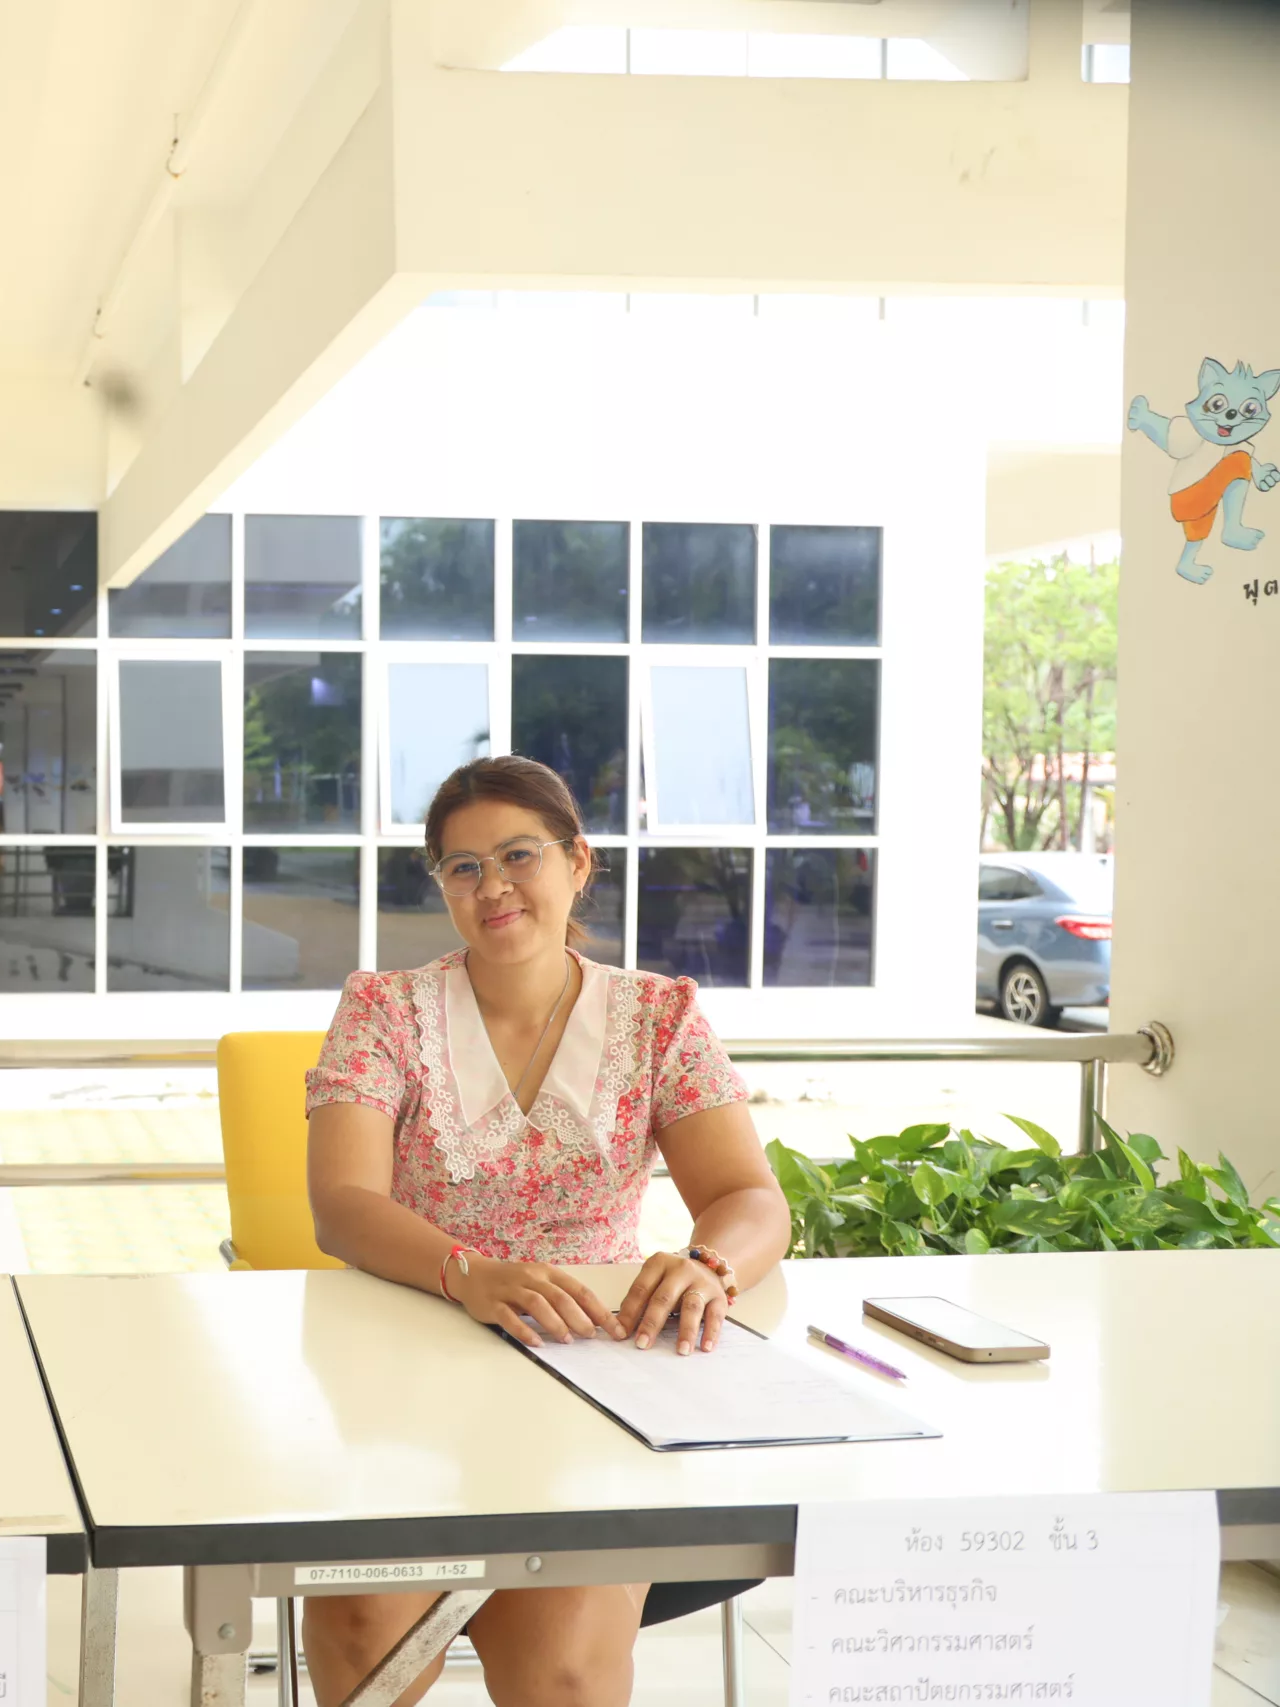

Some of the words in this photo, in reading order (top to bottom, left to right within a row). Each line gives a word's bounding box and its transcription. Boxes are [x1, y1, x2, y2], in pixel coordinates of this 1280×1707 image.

[905, 1527, 944, 1553] ห้อง
[961, 1530, 1025, 1552] 59302
[1049, 1516, 1078, 1551] ชั้น
[1087, 1530, 1099, 1550] 3
[310, 1566, 423, 1580] 07-7110-006-0633
[436, 1564, 467, 1576] /1-52
[834, 1578, 997, 1611] คณะบริหารธุรกิจ
[831, 1625, 1035, 1654] คณะวิศวกรรมศาสตร์
[828, 1673, 1075, 1703] คณะสถาปัตยกรรมศาสตร์
